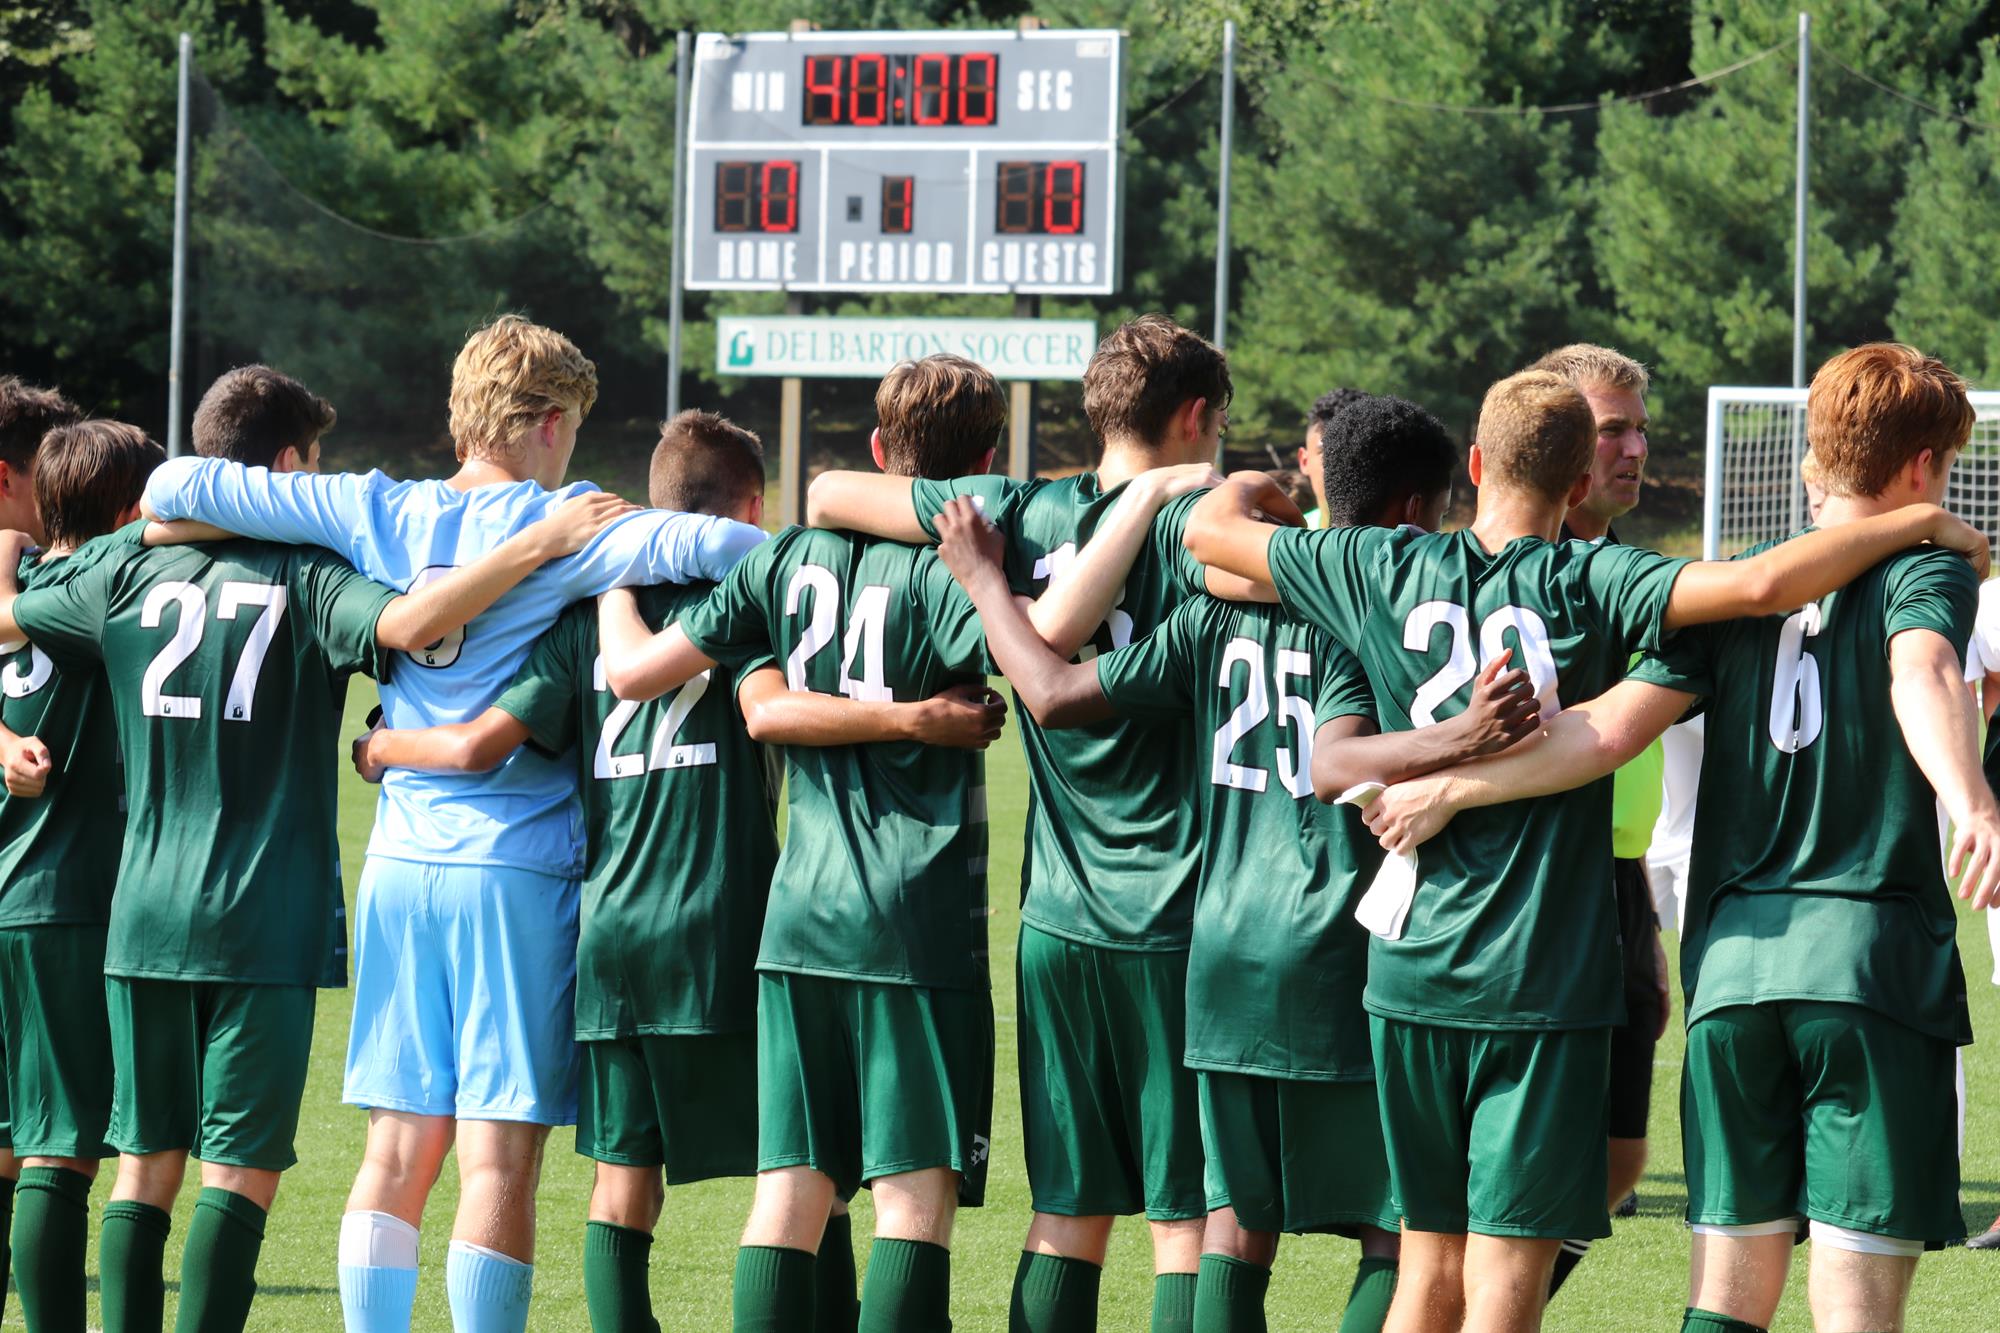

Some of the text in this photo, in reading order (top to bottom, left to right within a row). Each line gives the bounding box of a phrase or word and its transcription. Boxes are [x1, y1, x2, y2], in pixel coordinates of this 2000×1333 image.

[731, 71, 785, 112] MIN
[804, 53, 997, 126] 40:00
[1017, 70, 1073, 111] SEC
[760, 160, 797, 233] 0
[1043, 160, 1083, 235] 0
[717, 240, 797, 281] HOME
[839, 241, 954, 283] PERIOD
[982, 242, 1097, 285] GUESTS
[766, 331, 1083, 365] DELBARTON SOCCER
[140, 580, 288, 723] 27
[785, 563, 894, 702] 24
[1403, 600, 1562, 729] 20
[1768, 602, 1823, 755] 6
[593, 652, 718, 780] 22
[1211, 637, 1316, 800] 25
